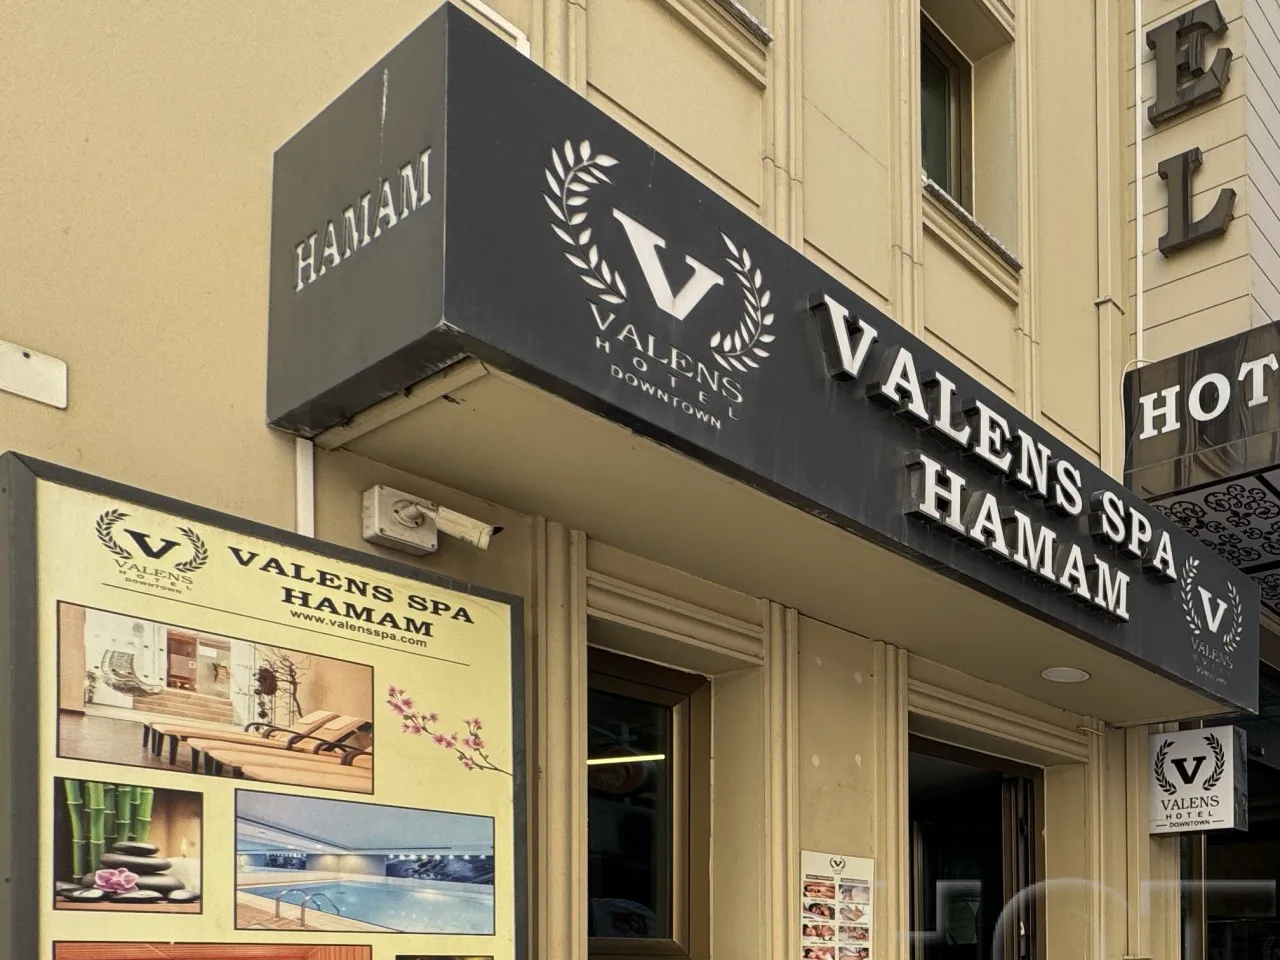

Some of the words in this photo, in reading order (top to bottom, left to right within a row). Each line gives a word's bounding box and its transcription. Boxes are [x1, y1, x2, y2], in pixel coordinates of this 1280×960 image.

[293, 145, 432, 292] HAMAM
[612, 207, 724, 320] V
[588, 300, 743, 403] VALENS
[595, 335, 739, 420] HOTEL
[611, 364, 721, 429] DOWNTOWN
[820, 292, 1084, 516] VALENS
[1100, 490, 1178, 582] SPA
[124, 528, 182, 561] V
[915, 453, 1130, 623] HAMAM
[114, 558, 194, 586] VALENS
[118, 569, 193, 593] HOTEL
[124, 576, 183, 595] DOWNTOWN
[228, 545, 394, 603] VALENS
[406, 593, 475, 625] SPA
[280, 585, 434, 639] HAMAM
[289, 608, 428, 649] www.valensspa.com
[1197, 585, 1228, 634] V
[1191, 636, 1233, 669] VALENS
[1169, 755, 1207, 785] V
[1161, 795, 1220, 811] VALENS
[1165, 810, 1214, 820] HOTEL
[1169, 820, 1210, 828] DOWNTOWN
